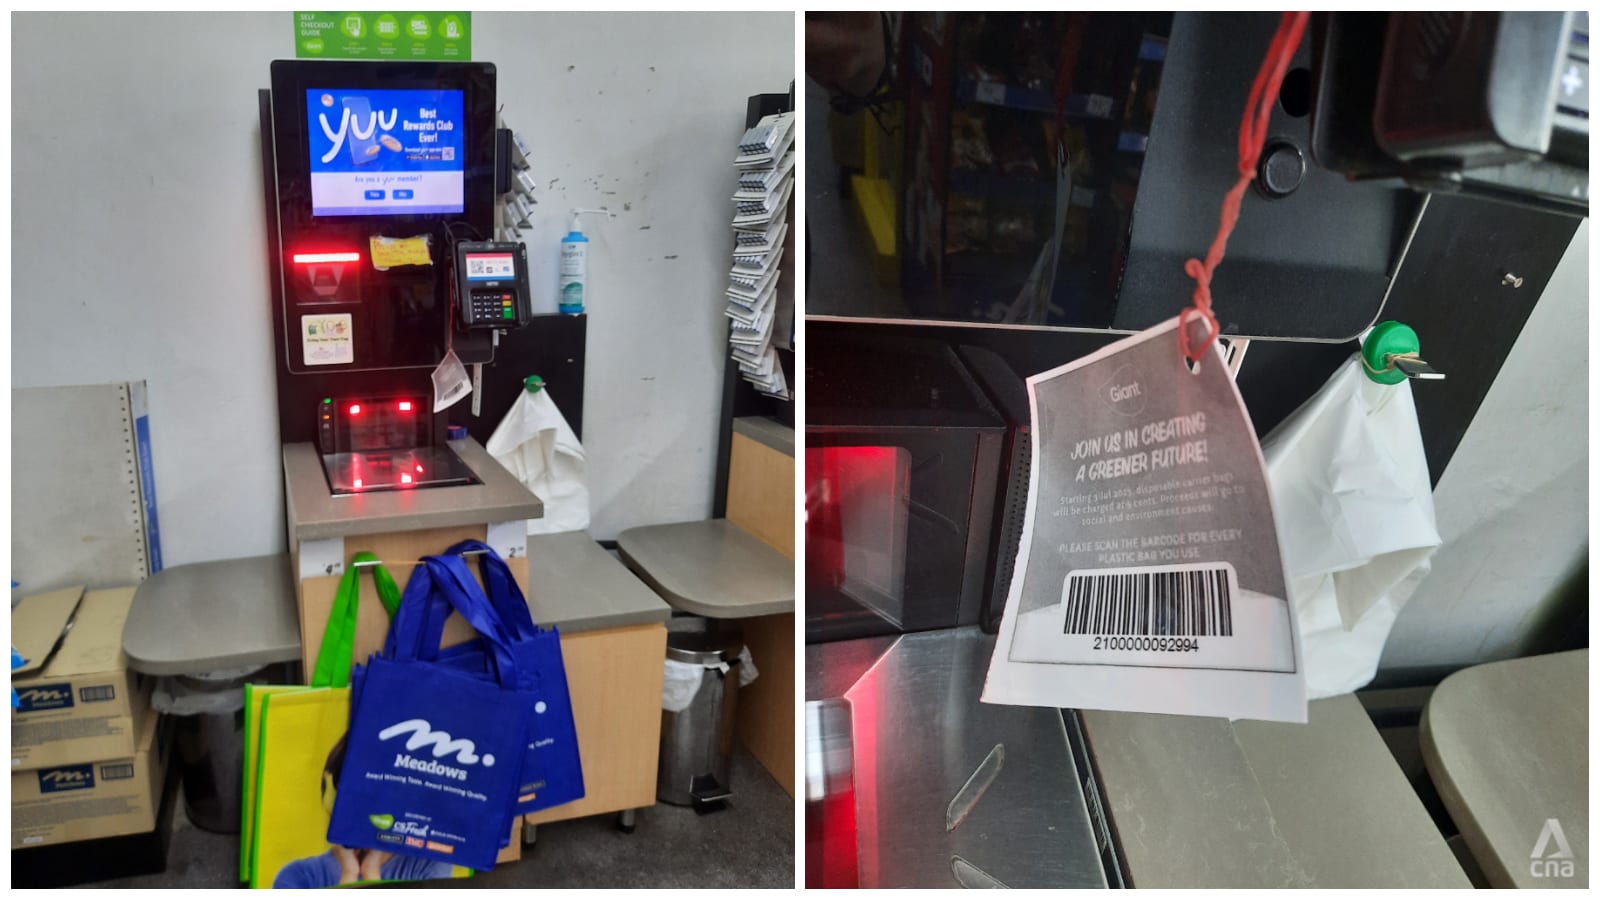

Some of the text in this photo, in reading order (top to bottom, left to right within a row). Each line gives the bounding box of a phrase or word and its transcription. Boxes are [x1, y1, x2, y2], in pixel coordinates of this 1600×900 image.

[419, 108, 437, 119] Best
[319, 107, 398, 164] yuu
[403, 120, 454, 131] Rewards Club
[418, 132, 438, 143] Ever!
[355, 175, 364, 183] Are
[397, 174, 423, 183] member?
[1110, 381, 1141, 402] Giant
[1071, 411, 1206, 460] JOIN US IN CREATING
[1076, 439, 1209, 482] A GREENER FUTURE!
[1060, 493, 1092, 505] Starting
[1100, 488, 1112, 501] Jul
[1135, 479, 1180, 496] disposable
[1182, 475, 1211, 488] carrier
[1212, 471, 1234, 485] bags
[1053, 505, 1069, 517] will
[1071, 503, 1080, 516] be
[1082, 501, 1115, 515] charged
[1160, 491, 1200, 503] Proceeds
[1201, 485, 1219, 498] will
[1220, 486, 1232, 500] go
[1233, 485, 1246, 495] to
[1081, 514, 1106, 527] social
[1108, 512, 1124, 524] and
[1125, 506, 1180, 521] environment
[1059, 528, 1242, 554] PLEASE SCAN THE BARCODE FOR EVERY
[1099, 546, 1201, 564] PLASTIC BAG YOU USE
[1093, 636, 1200, 653] 2100000092994
[394, 753, 468, 781] Meadows
[365, 771, 384, 780] Award
[384, 773, 407, 784] Winning
[424, 780, 443, 791] Award
[443, 785, 466, 797] Winning
